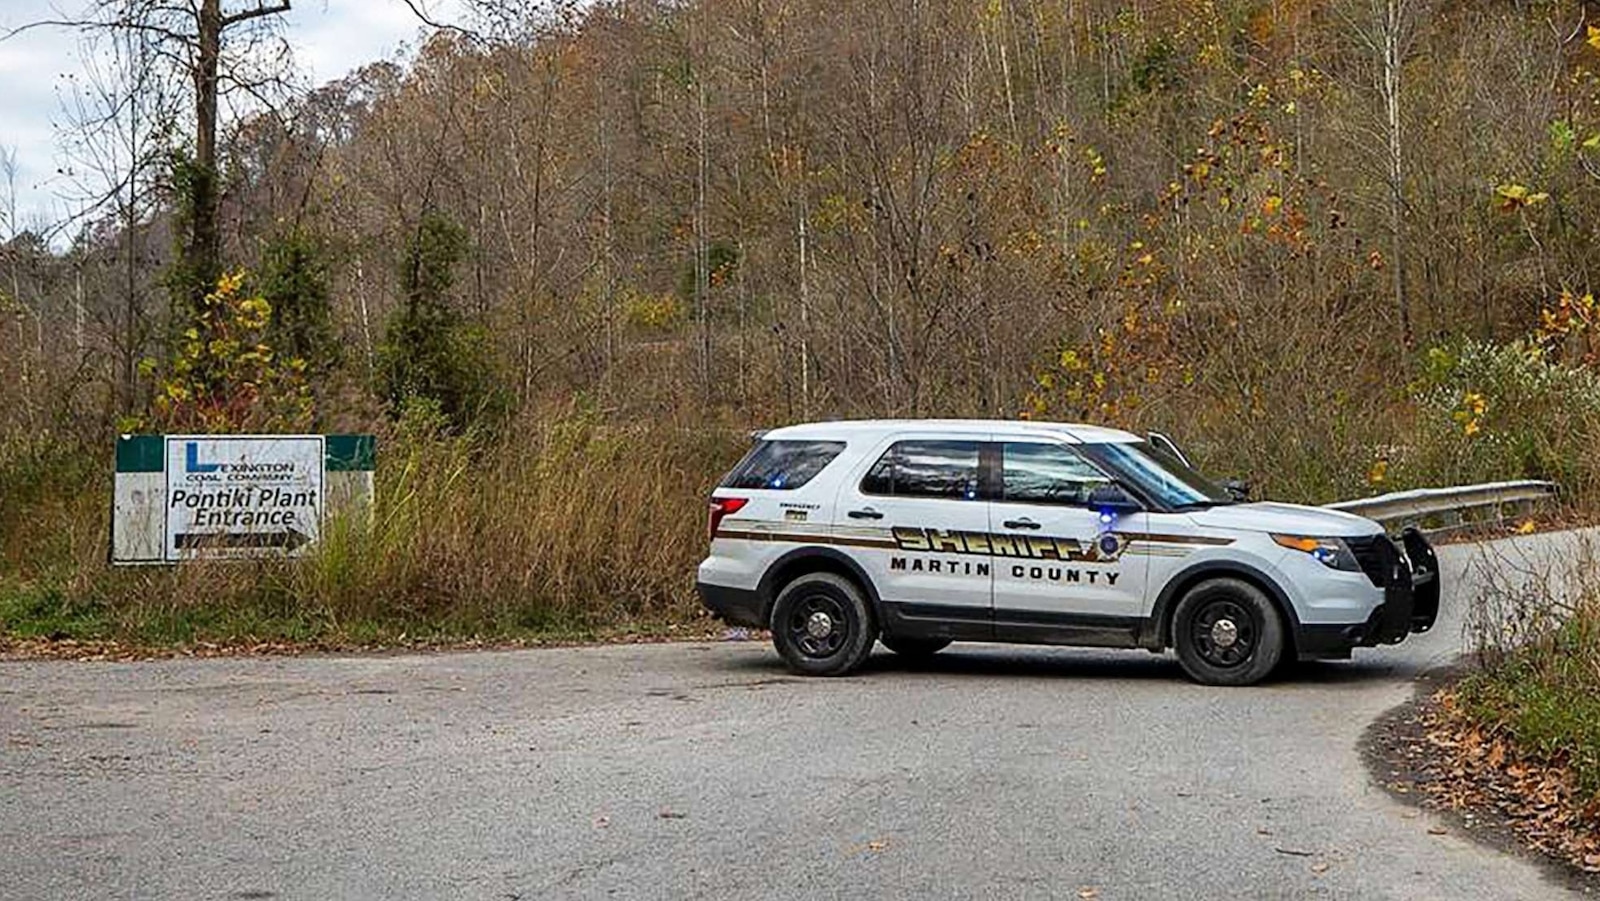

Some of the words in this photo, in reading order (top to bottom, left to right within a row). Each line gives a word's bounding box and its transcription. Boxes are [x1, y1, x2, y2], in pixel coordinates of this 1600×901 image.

[186, 442, 296, 473] LEXINGTON
[186, 474, 221, 482] COAL
[227, 474, 294, 482] COMPANY
[171, 488, 251, 508] Pontiki
[258, 488, 317, 508] Plant
[194, 507, 296, 527] Entrance
[891, 526, 1084, 561] SHERIFF
[891, 557, 990, 576] MARTIN
[1012, 565, 1120, 585] COUNTY
